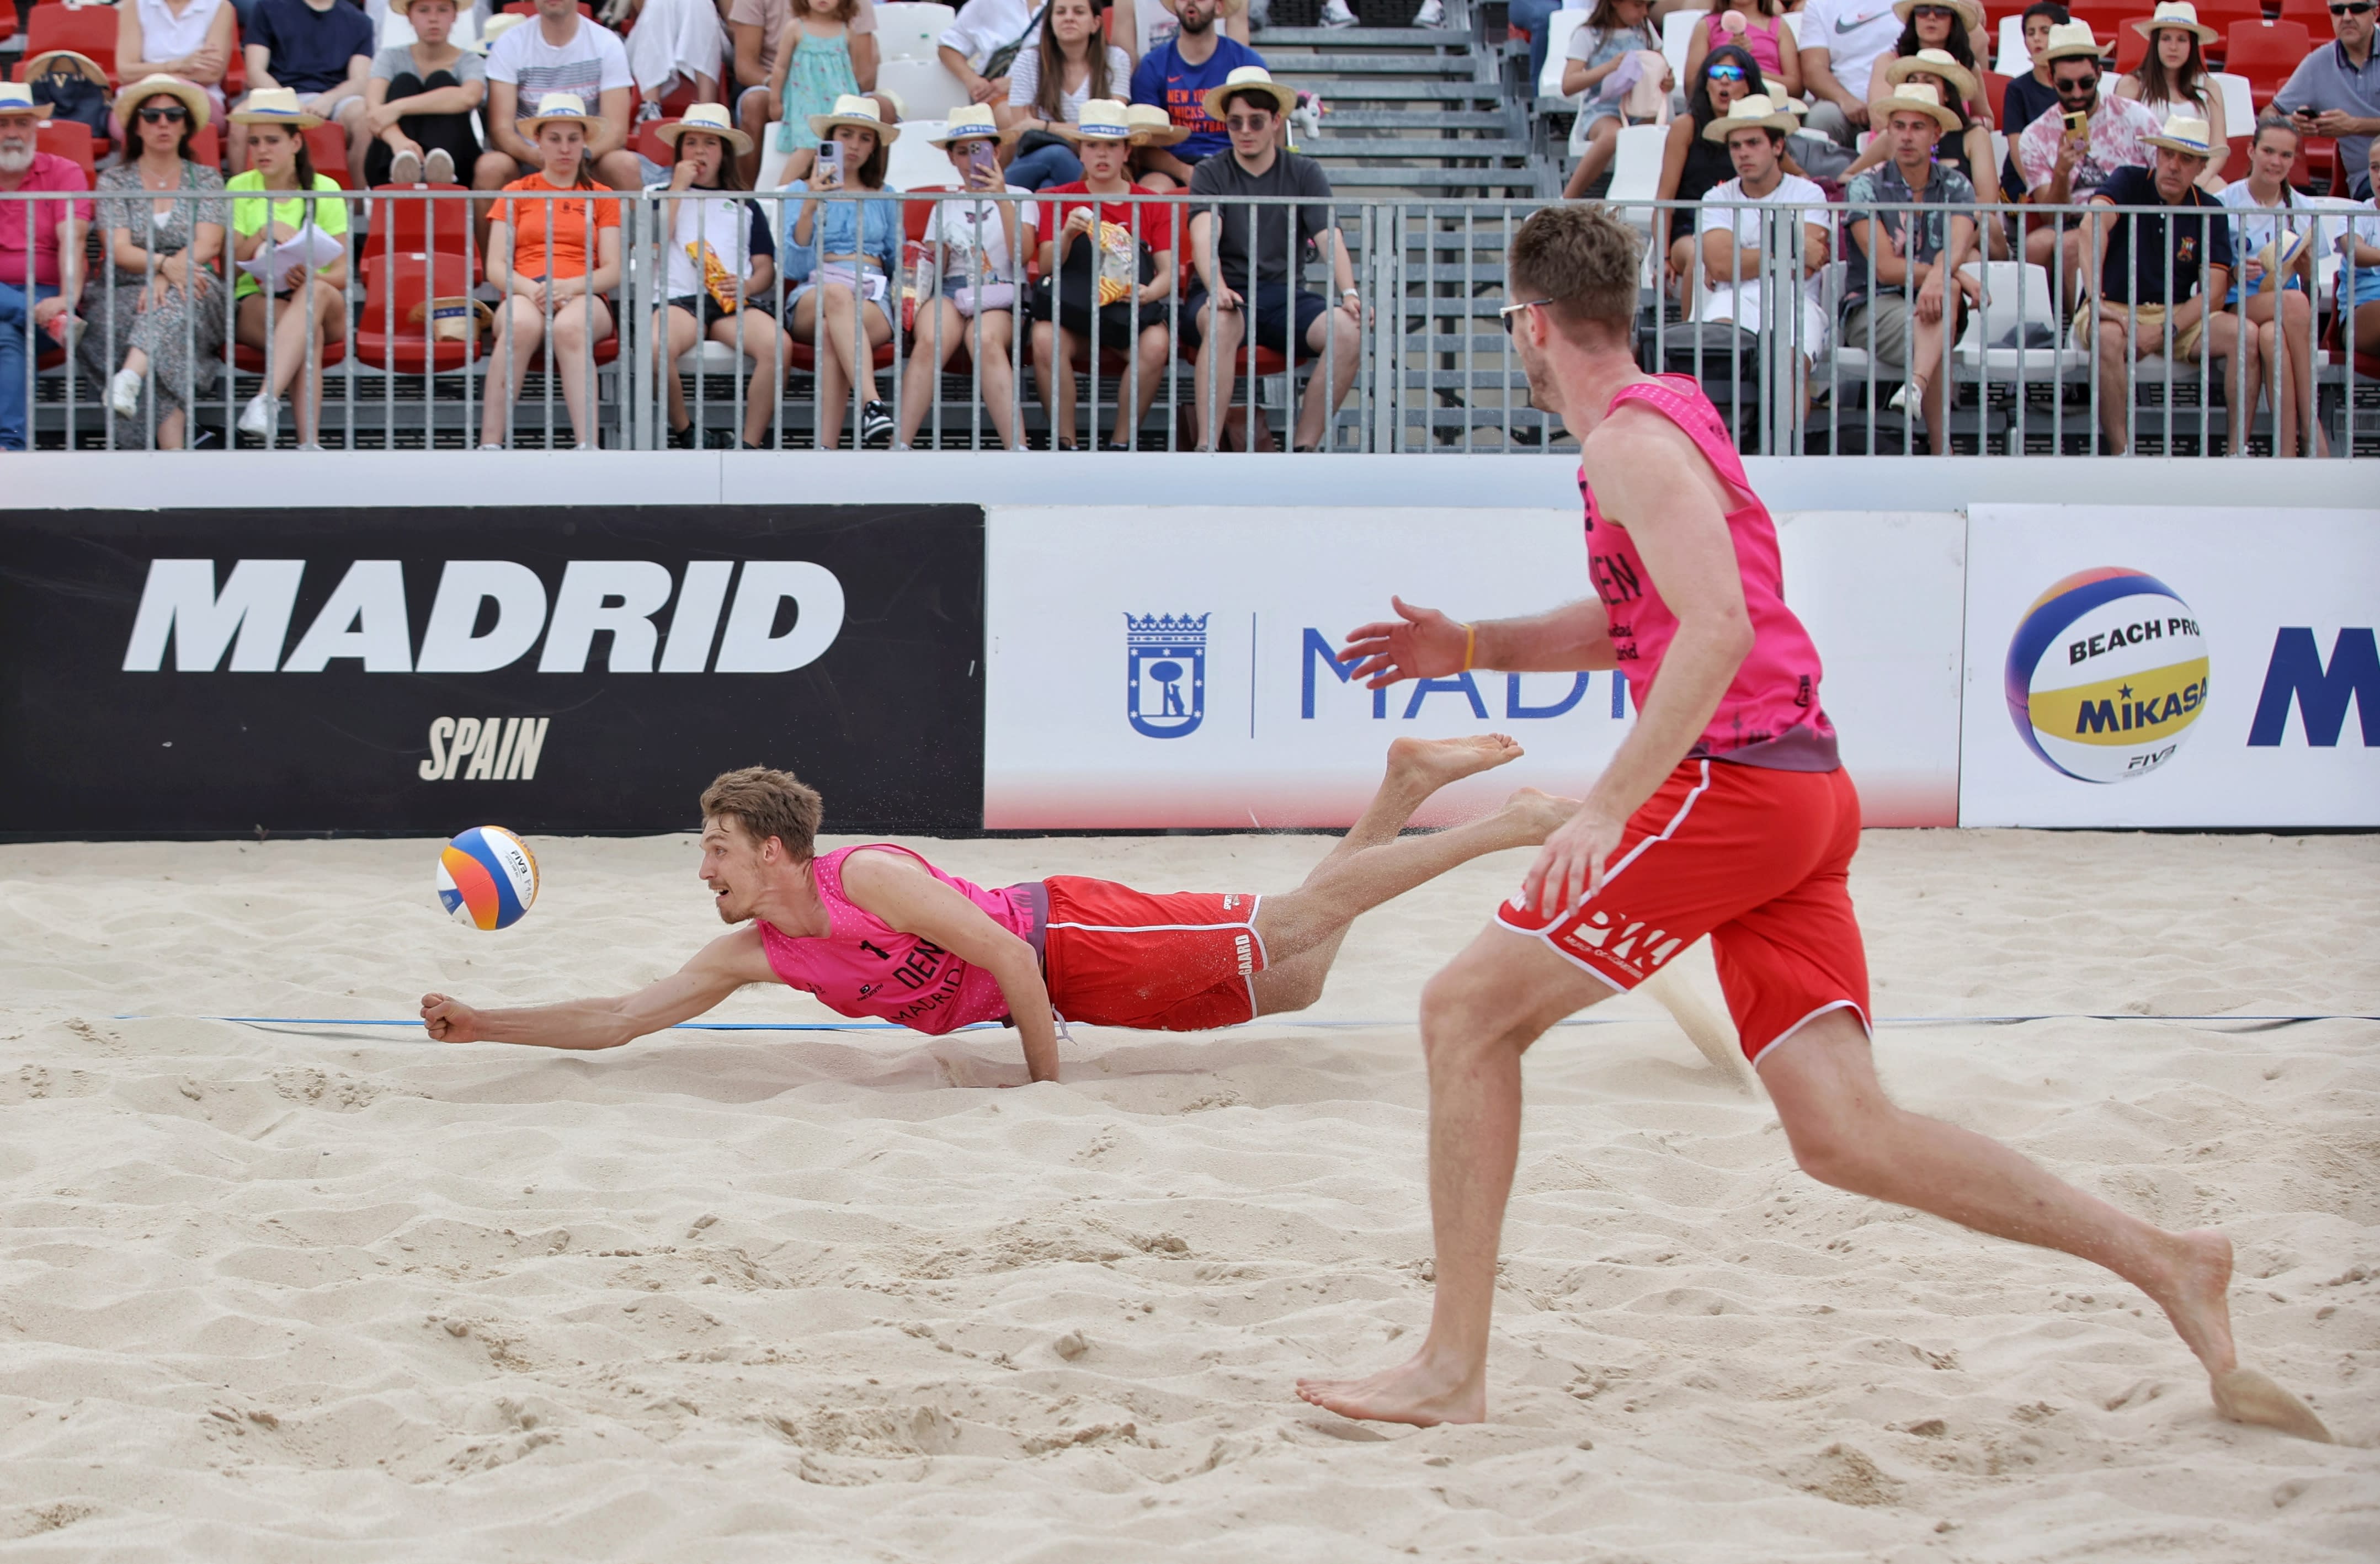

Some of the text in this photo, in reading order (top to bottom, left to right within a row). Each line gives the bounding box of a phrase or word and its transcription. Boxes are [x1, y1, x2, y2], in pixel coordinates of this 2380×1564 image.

[1168, 89, 1189, 103] NEW
[123, 558, 845, 672] MADRID
[2069, 618, 2200, 666] BEACH PRO
[419, 716, 550, 781] SPAIN
[510, 850, 528, 874] FIVB
[859, 940, 891, 960] 1
[892, 938, 945, 990] DEN
[1235, 934, 1253, 975] GAARD
[890, 968, 961, 1022] MADRID
